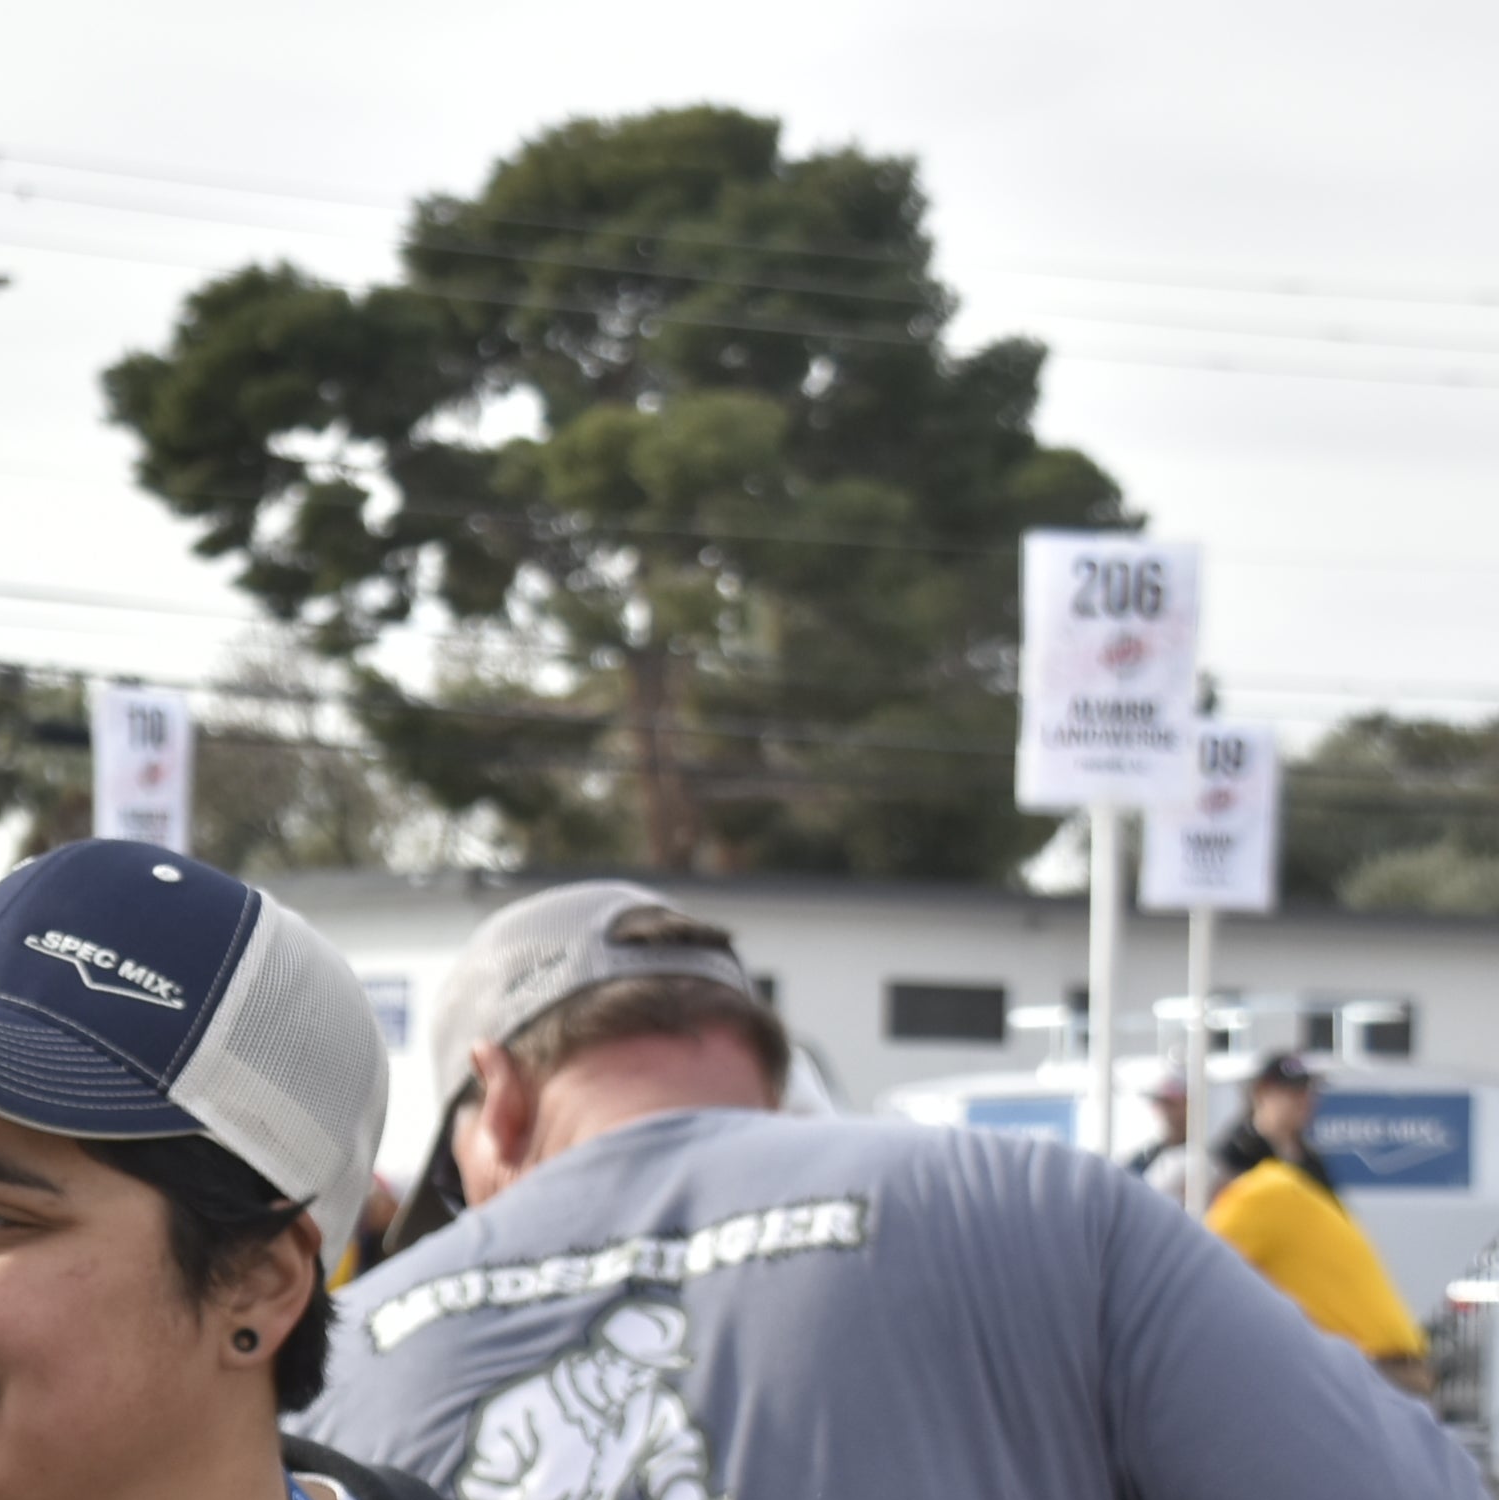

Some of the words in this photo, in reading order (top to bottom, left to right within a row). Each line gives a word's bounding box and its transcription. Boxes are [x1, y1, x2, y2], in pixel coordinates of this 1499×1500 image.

[1072, 558, 1165, 619] 206
[1199, 736, 1245, 776] 09
[42, 929, 119, 970] SPEC
